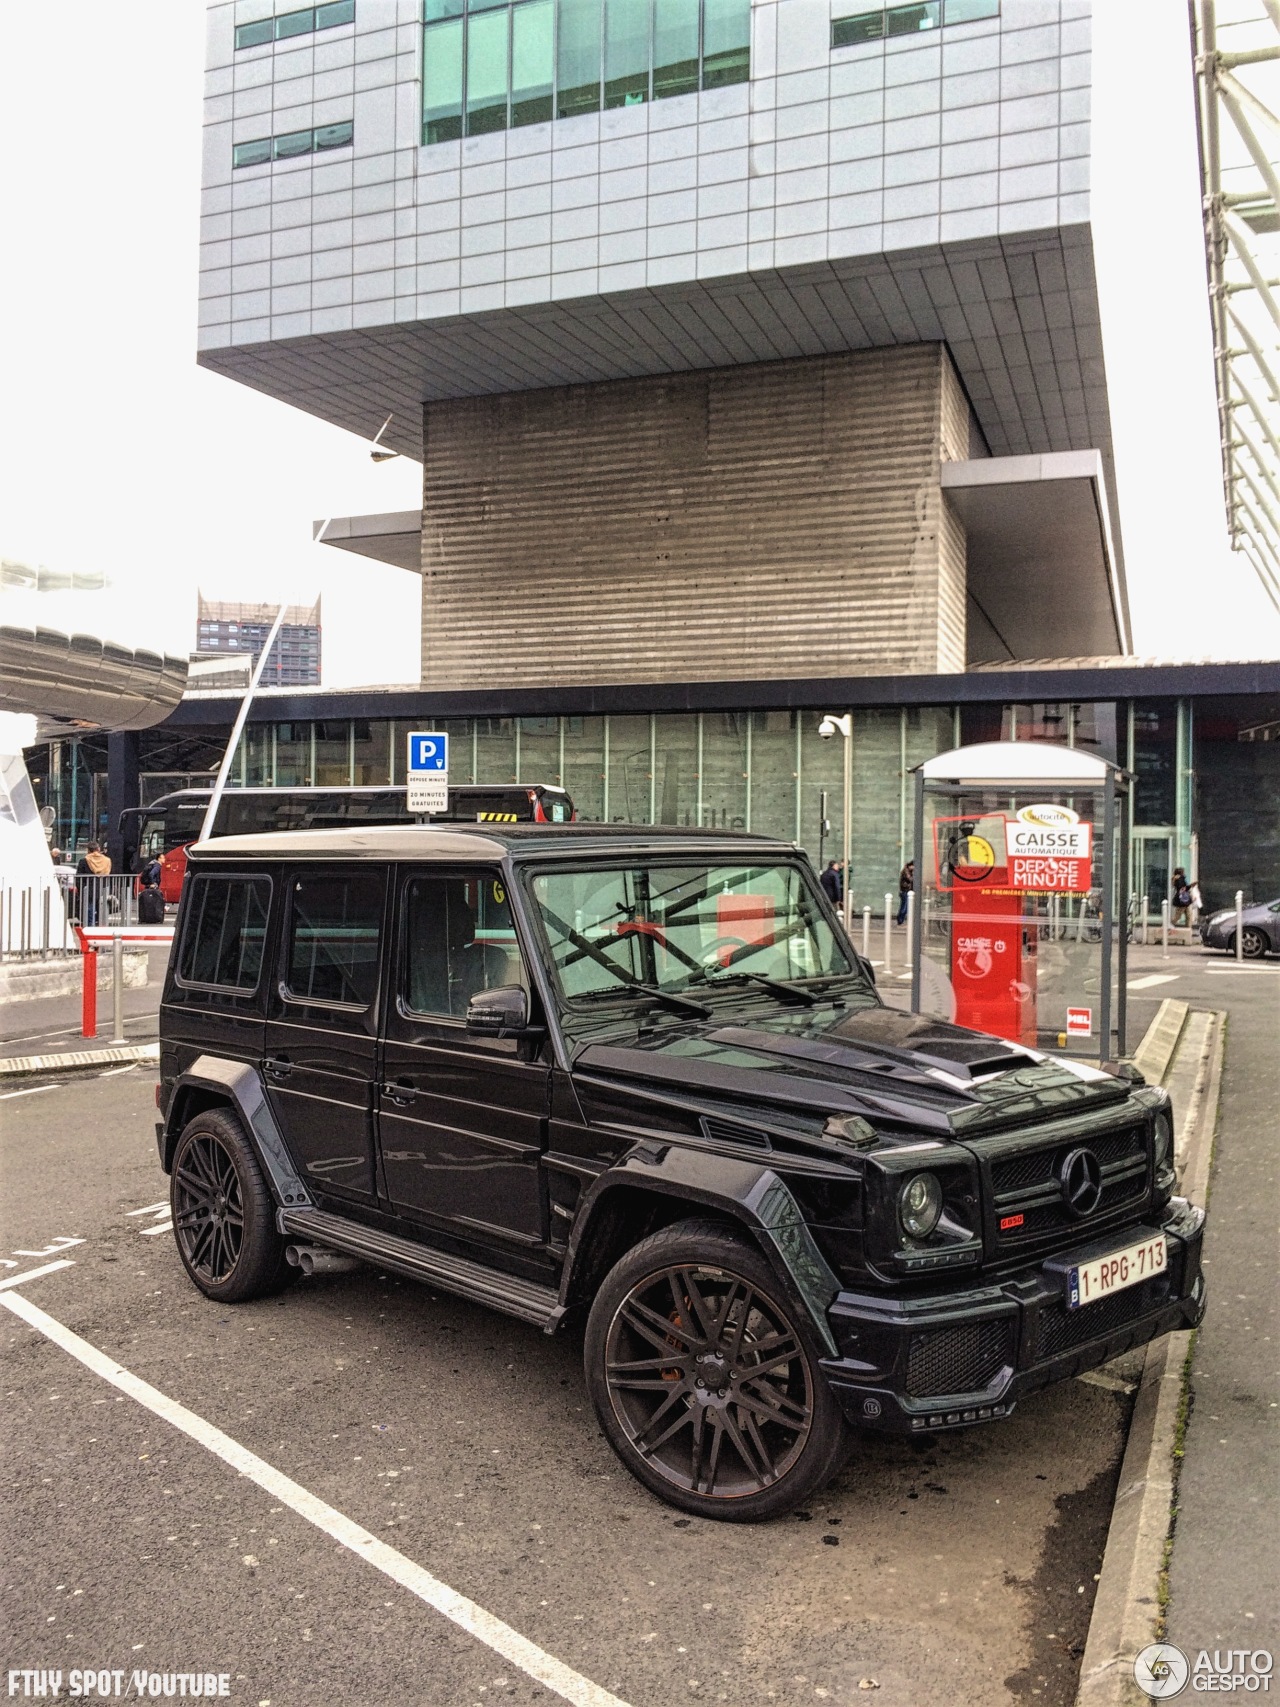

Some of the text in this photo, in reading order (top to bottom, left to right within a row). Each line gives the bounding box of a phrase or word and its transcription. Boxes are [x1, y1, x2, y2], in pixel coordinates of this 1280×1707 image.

[419, 740, 437, 764] P
[1015, 833, 1079, 847] CAISSE
[1014, 847, 1078, 856] AUTOMATIQUE
[1013, 873, 1079, 888] MINUTE
[1082, 1241, 1164, 1297] 1-RPG-713
